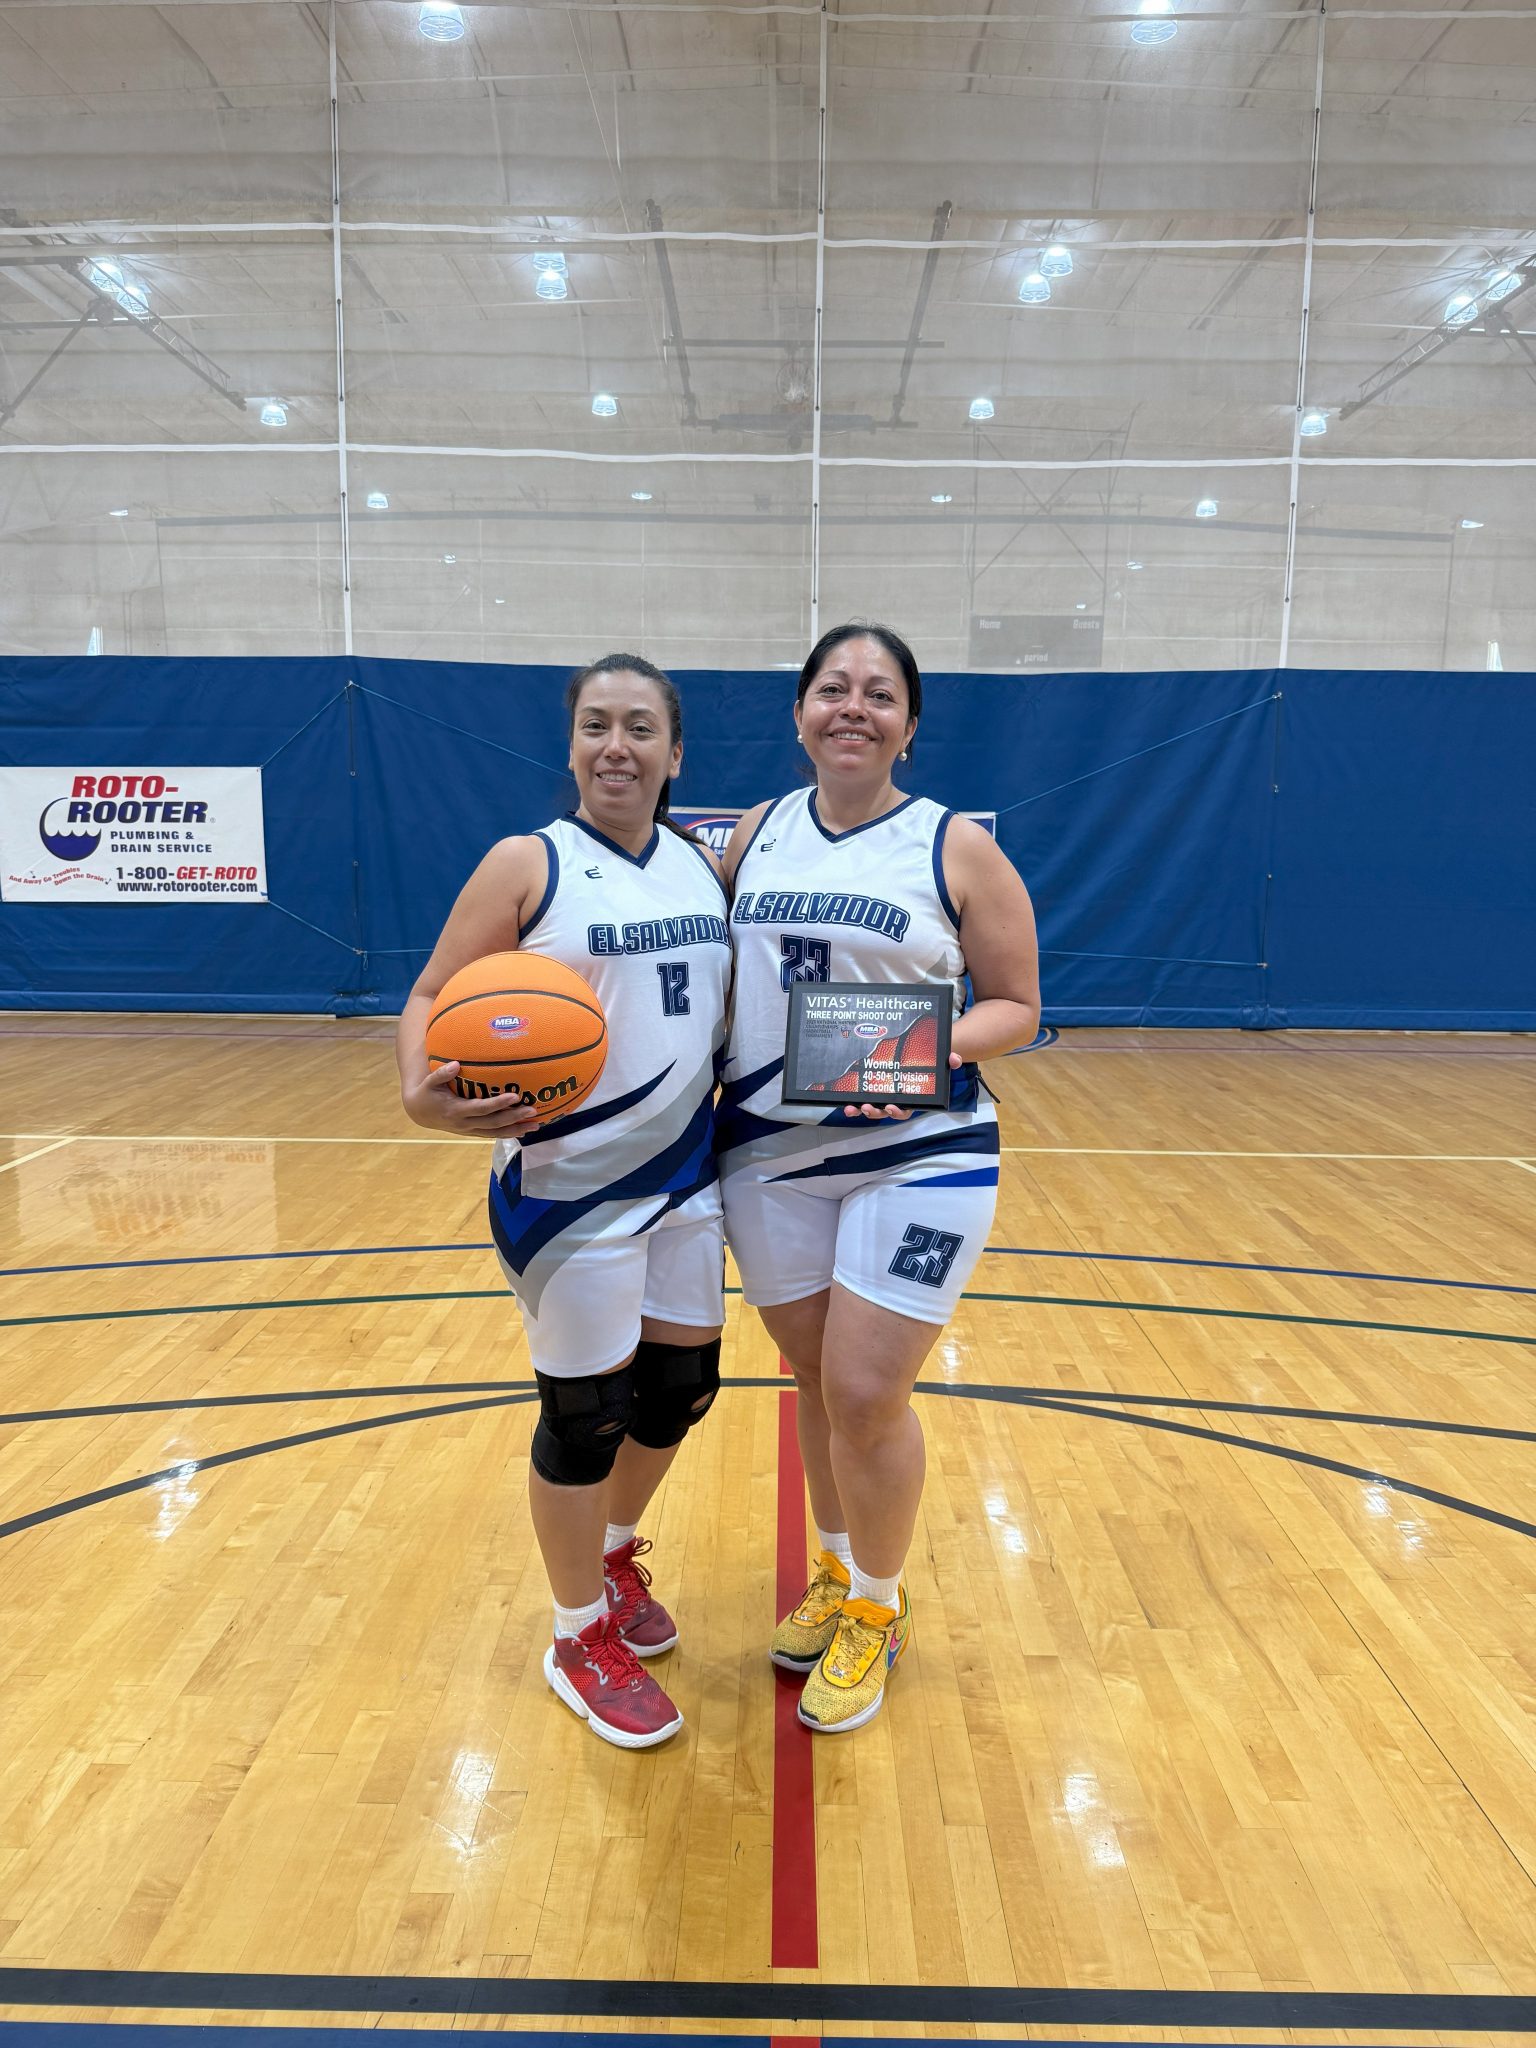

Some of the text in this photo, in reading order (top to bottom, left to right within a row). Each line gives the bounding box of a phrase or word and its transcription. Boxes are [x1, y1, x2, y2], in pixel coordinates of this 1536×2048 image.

[979, 619, 1001, 630] Home
[1024, 653, 1049, 664] period
[71, 775, 179, 799] ROTO-
[67, 801, 209, 824] ROOTER
[110, 831, 194, 840] PLUMBING &
[111, 844, 213, 853] DRAIN SERVICE
[9, 875, 22, 883] And
[52, 867, 81, 879] Troubles
[116, 866, 258, 880] 1-800-GET-ROTO
[54, 876, 72, 886] Down
[117, 881, 258, 893] www.rotorooter.com
[734, 892, 911, 943] EL SALVADOR
[588, 924, 624, 955] EL
[780, 934, 832, 993] 23
[656, 962, 690, 1017] 12
[807, 996, 933, 1010] VITAS Healthcare
[495, 1017, 520, 1026] MBA
[806, 1010, 903, 1021] THREE POINT SHOOT OUT
[860, 1026, 879, 1034] MBA
[863, 1058, 900, 1070] Women
[863, 1070, 929, 1083] 40-50+ Division
[862, 1081, 921, 1094] Second Place
[888, 1223, 964, 1288] 23
